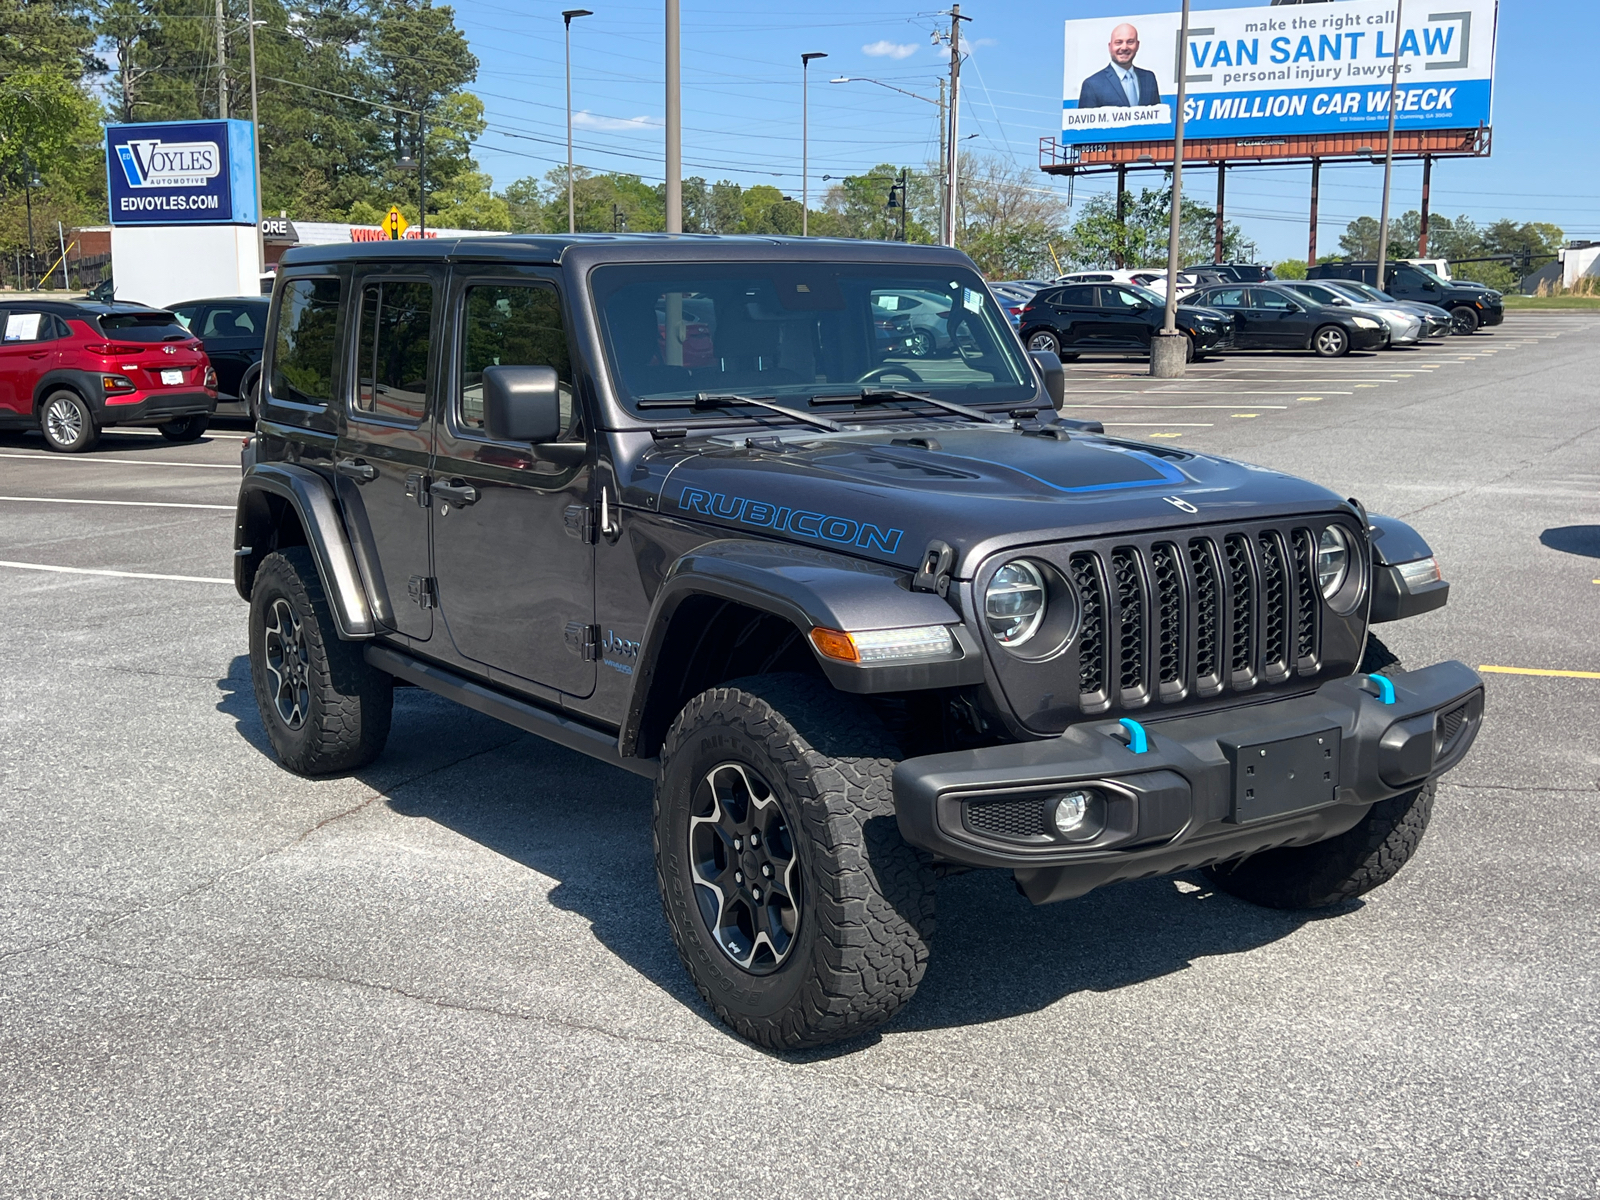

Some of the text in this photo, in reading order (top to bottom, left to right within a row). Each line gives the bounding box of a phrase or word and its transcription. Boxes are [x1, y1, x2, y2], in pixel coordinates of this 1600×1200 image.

[1245, 10, 1395, 32] make the right call
[1189, 26, 1455, 68] VAN SANT LAW
[1223, 62, 1412, 86] personal injury lawyers
[1183, 88, 1457, 123] $1 MILLION CAR WRECK
[1068, 109, 1160, 125] DAVID M. VAN SANT
[150, 177, 205, 185] AUTOMOTIVE
[120, 194, 219, 211] EDVOYLES.COM
[262, 220, 288, 234] ORE
[678, 486, 904, 554] RUBICON
